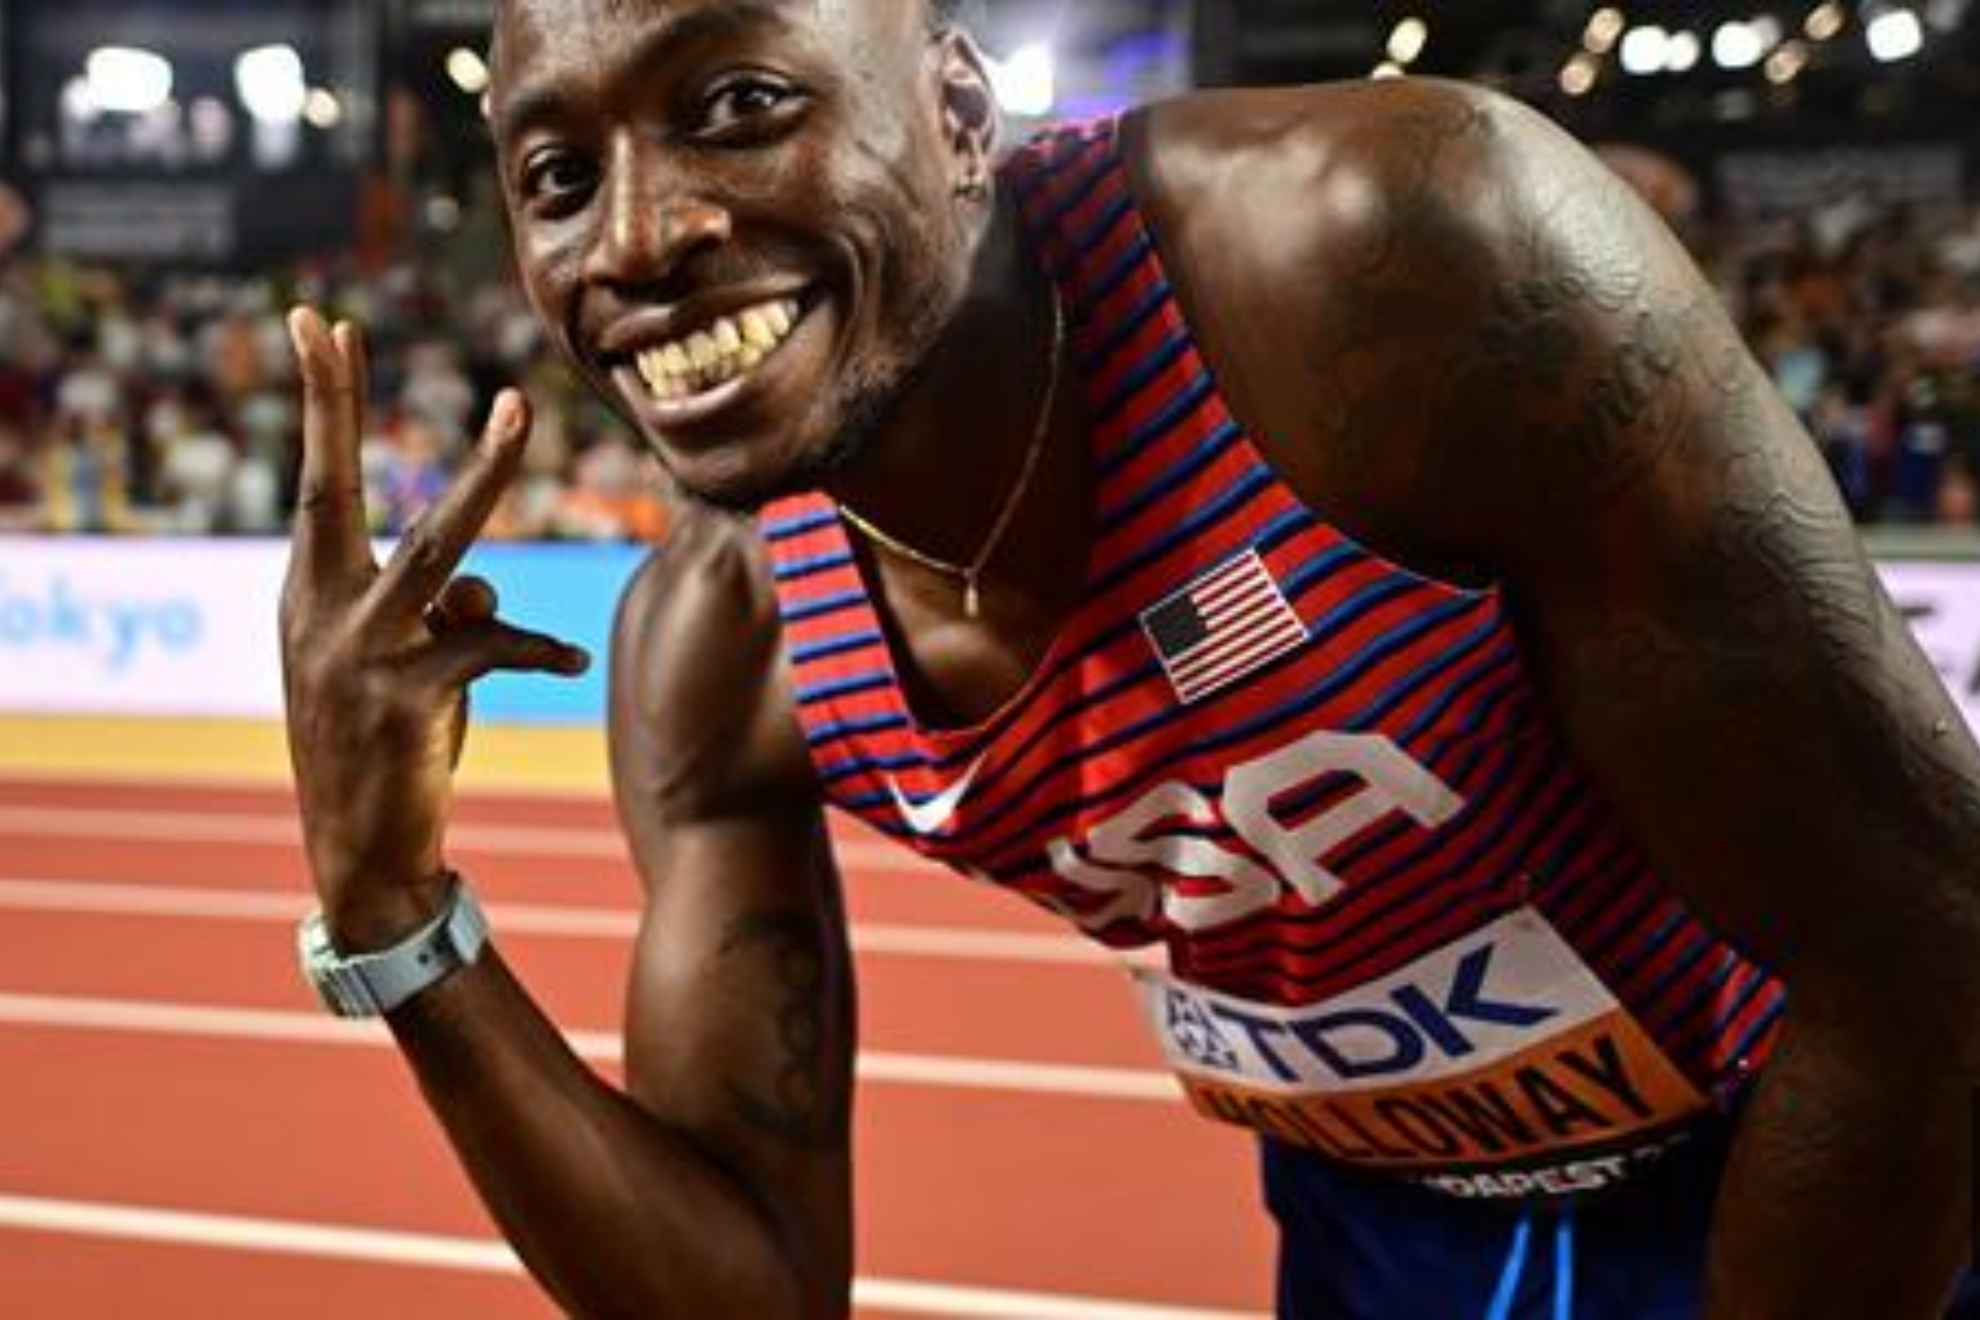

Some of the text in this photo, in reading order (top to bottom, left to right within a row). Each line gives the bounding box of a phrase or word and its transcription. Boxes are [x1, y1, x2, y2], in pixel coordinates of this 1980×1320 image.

[0, 572, 203, 672] okyo
[1047, 730, 1466, 931] USA
[1210, 942, 1558, 1082] TDK
